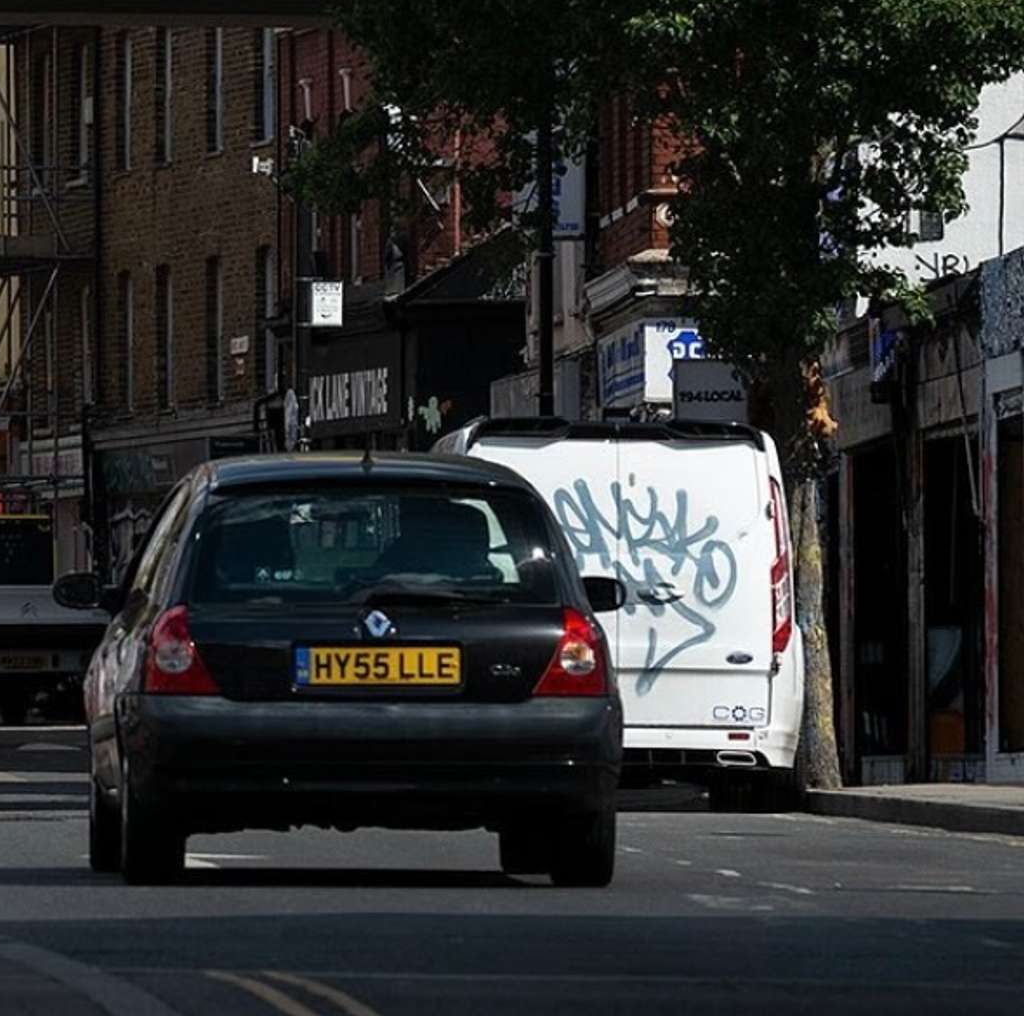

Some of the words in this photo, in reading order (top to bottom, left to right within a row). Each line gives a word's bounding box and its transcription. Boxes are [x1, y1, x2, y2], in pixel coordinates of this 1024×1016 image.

[314, 653, 389, 680] HY55
[399, 653, 455, 680] LLE
[713, 705, 766, 722] COG
